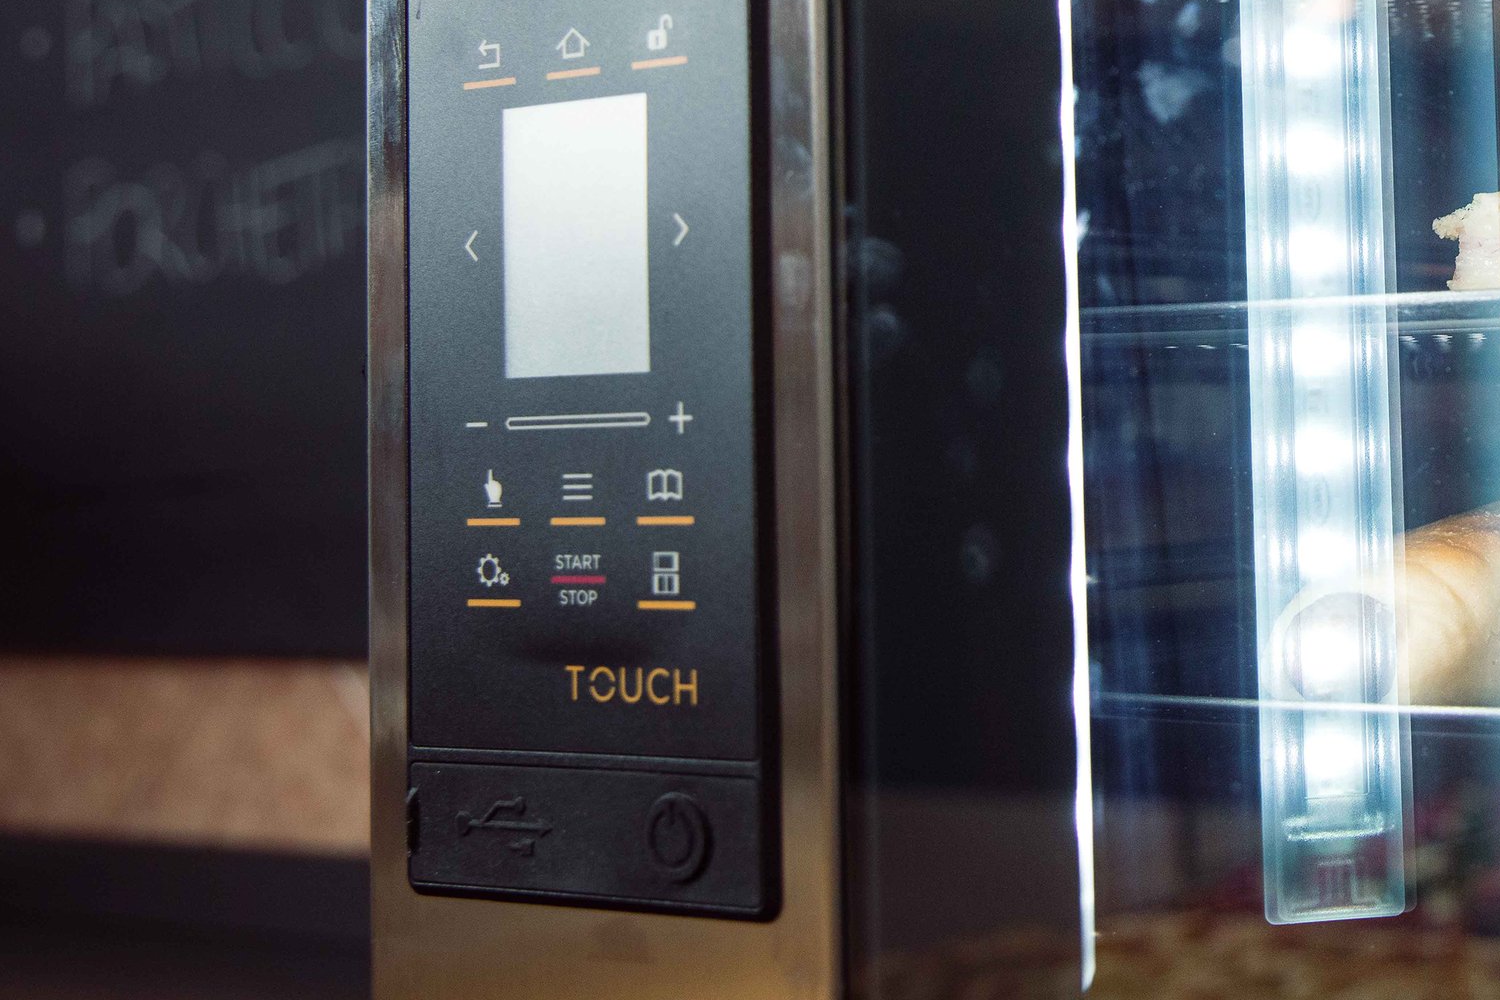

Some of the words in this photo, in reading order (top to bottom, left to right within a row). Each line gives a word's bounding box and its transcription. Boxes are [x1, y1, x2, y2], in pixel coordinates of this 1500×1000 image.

[555, 553, 601, 571] START
[559, 588, 598, 607] STOP
[564, 664, 699, 706] TOUCH
